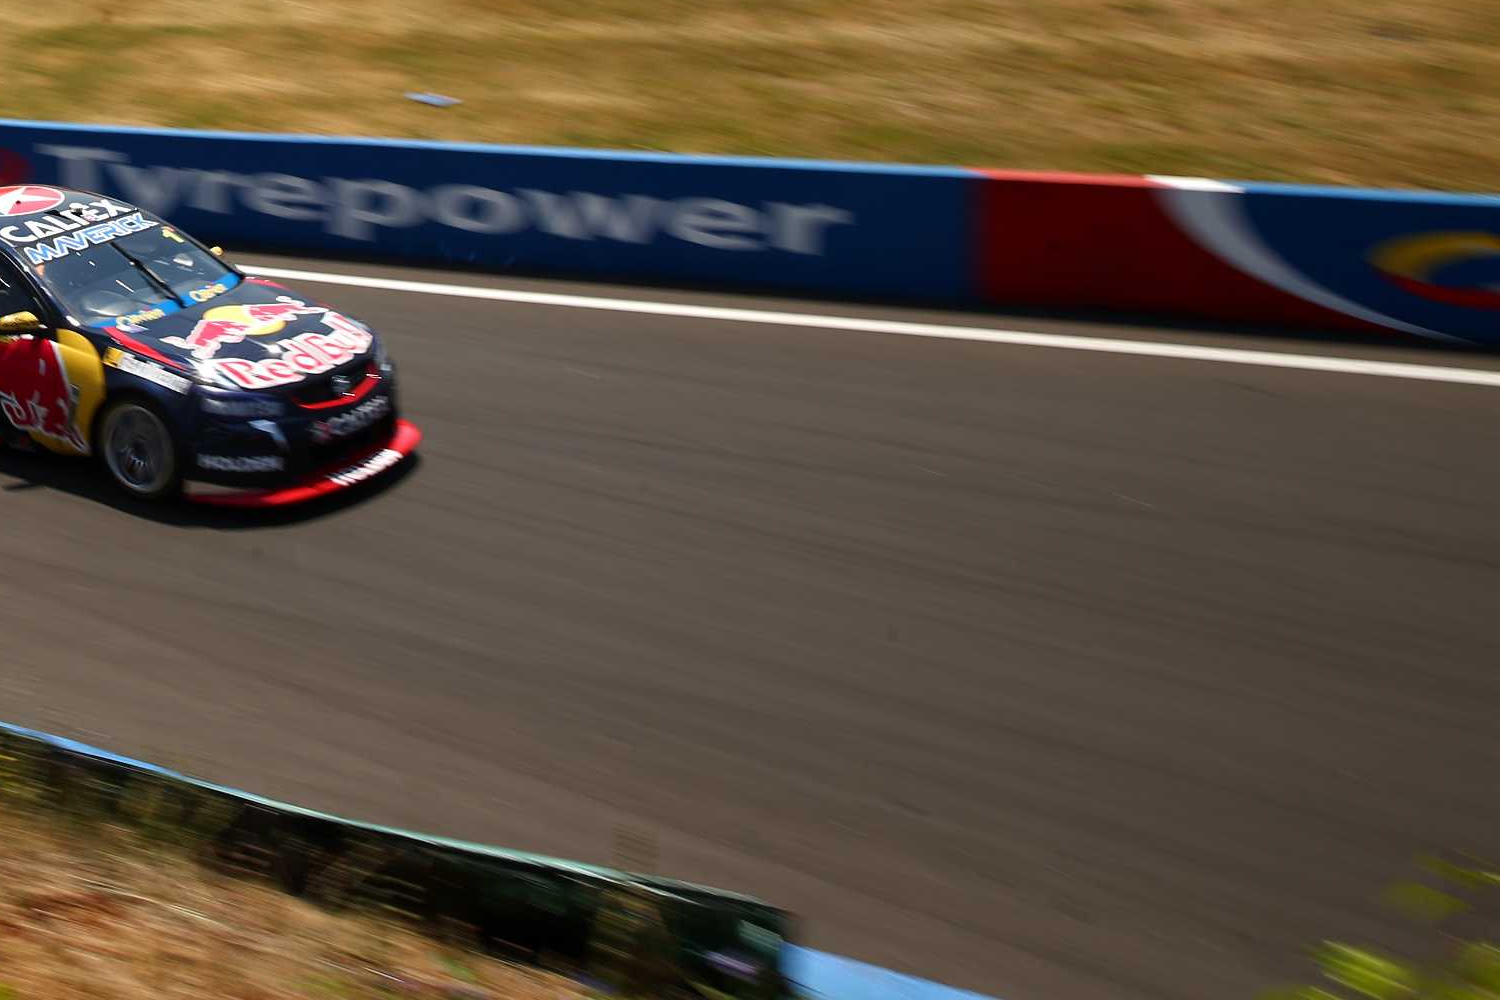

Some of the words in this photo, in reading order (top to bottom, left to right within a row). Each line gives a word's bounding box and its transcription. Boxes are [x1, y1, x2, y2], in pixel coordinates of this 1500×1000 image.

[0, 199, 132, 243] CALTEX
[32, 142, 853, 257] Tyrepower
[23, 212, 160, 265] MAVERICK
